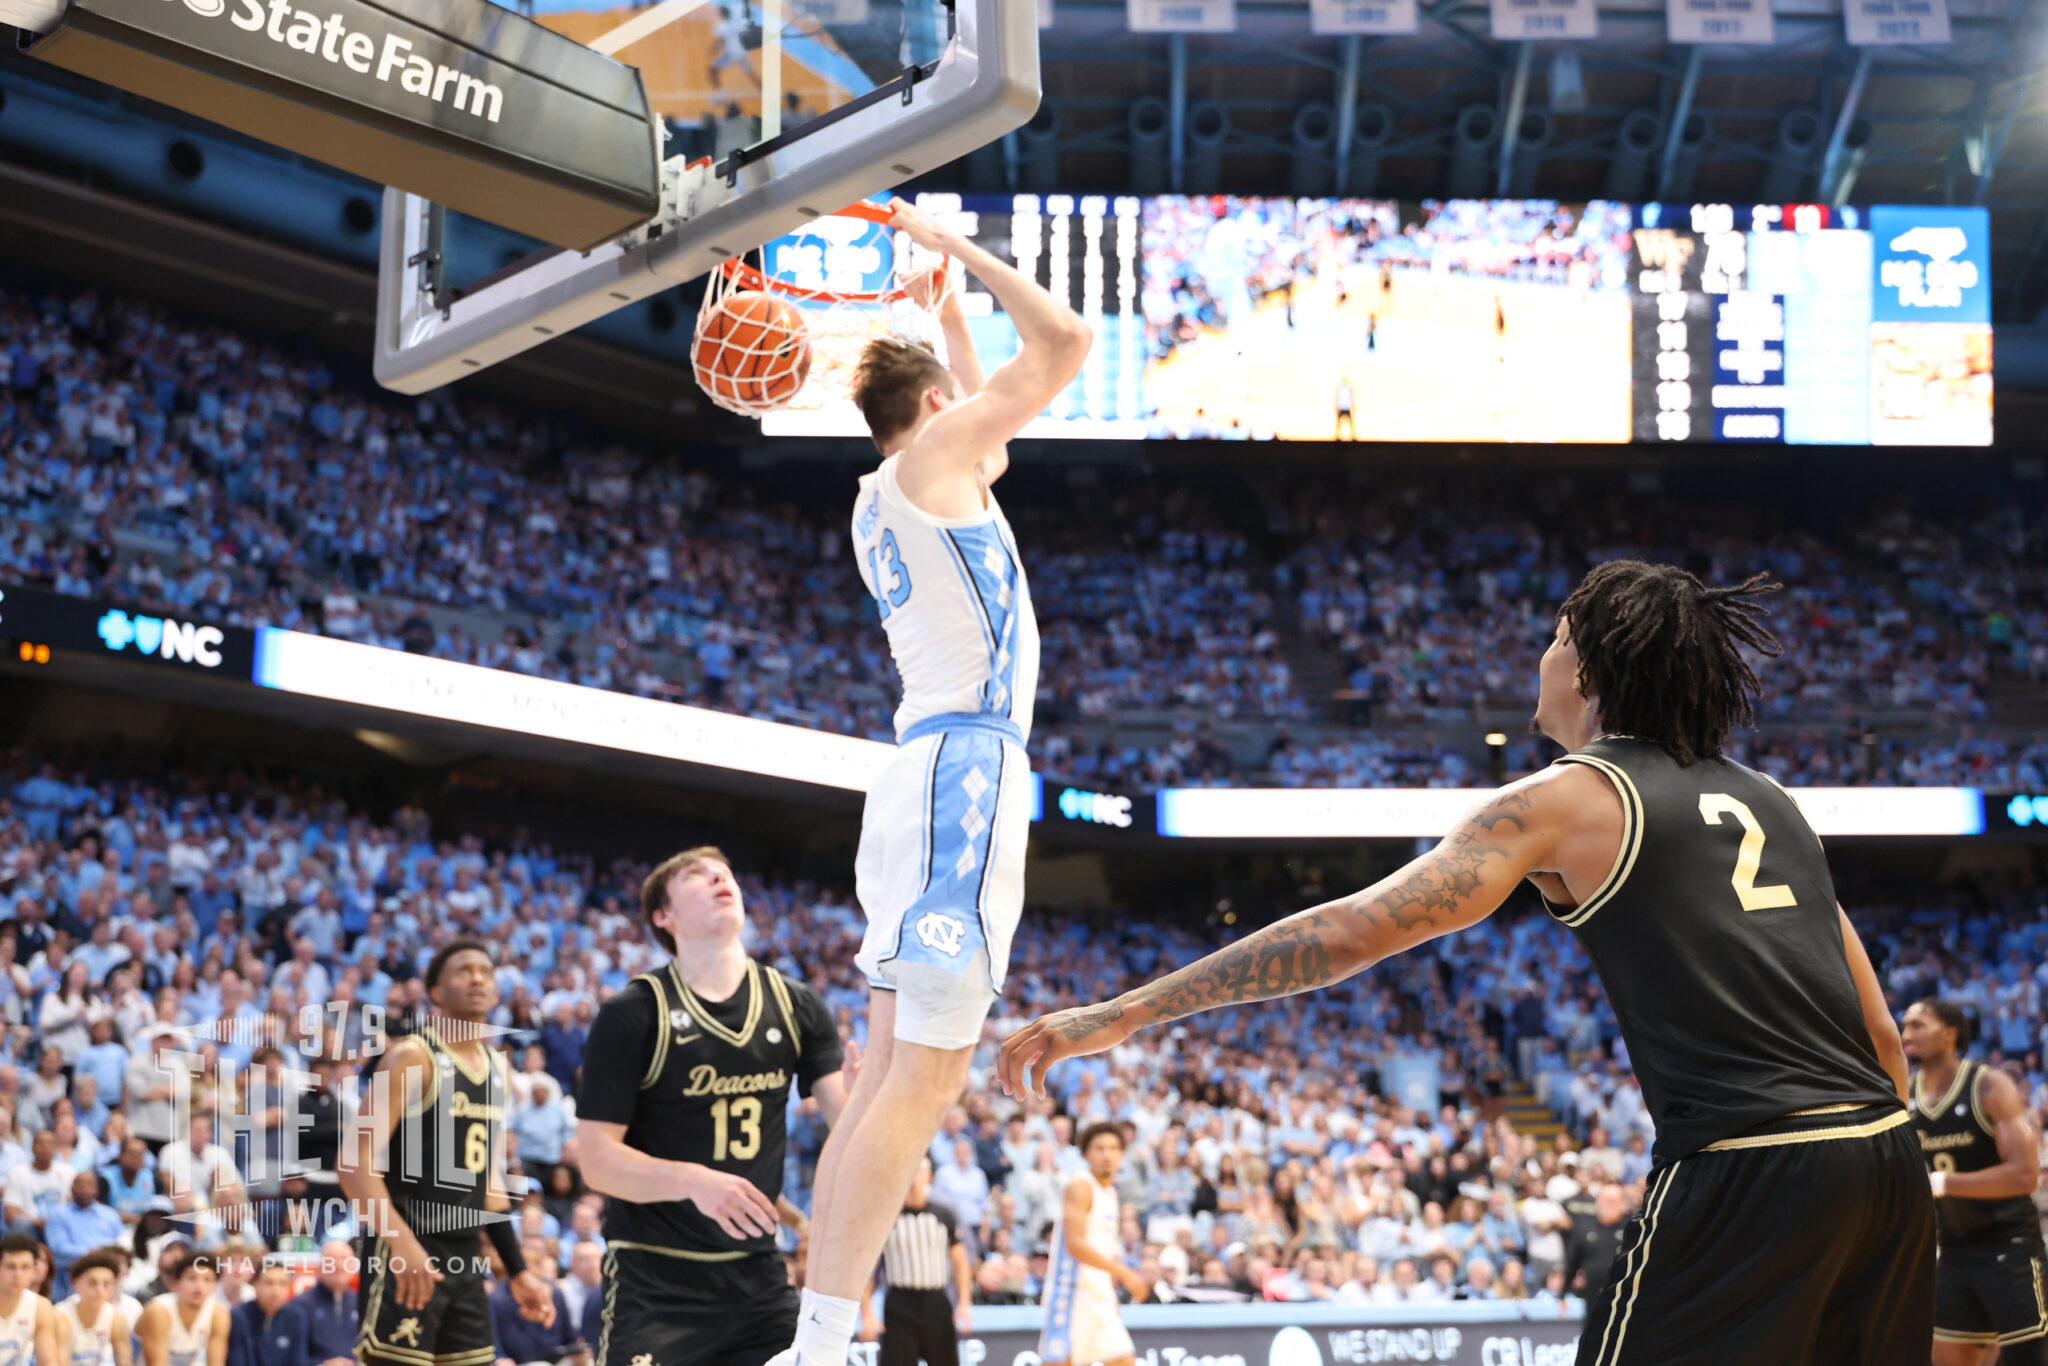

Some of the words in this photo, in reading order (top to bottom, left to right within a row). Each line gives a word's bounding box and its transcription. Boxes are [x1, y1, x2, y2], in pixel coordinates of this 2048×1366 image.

[868, 527, 912, 619] 13
[161, 618, 224, 668] NC
[1698, 793, 1797, 911] 2
[683, 1064, 788, 1096] Deacons
[464, 1122, 487, 1174] 6
[710, 1096, 762, 1161] 13
